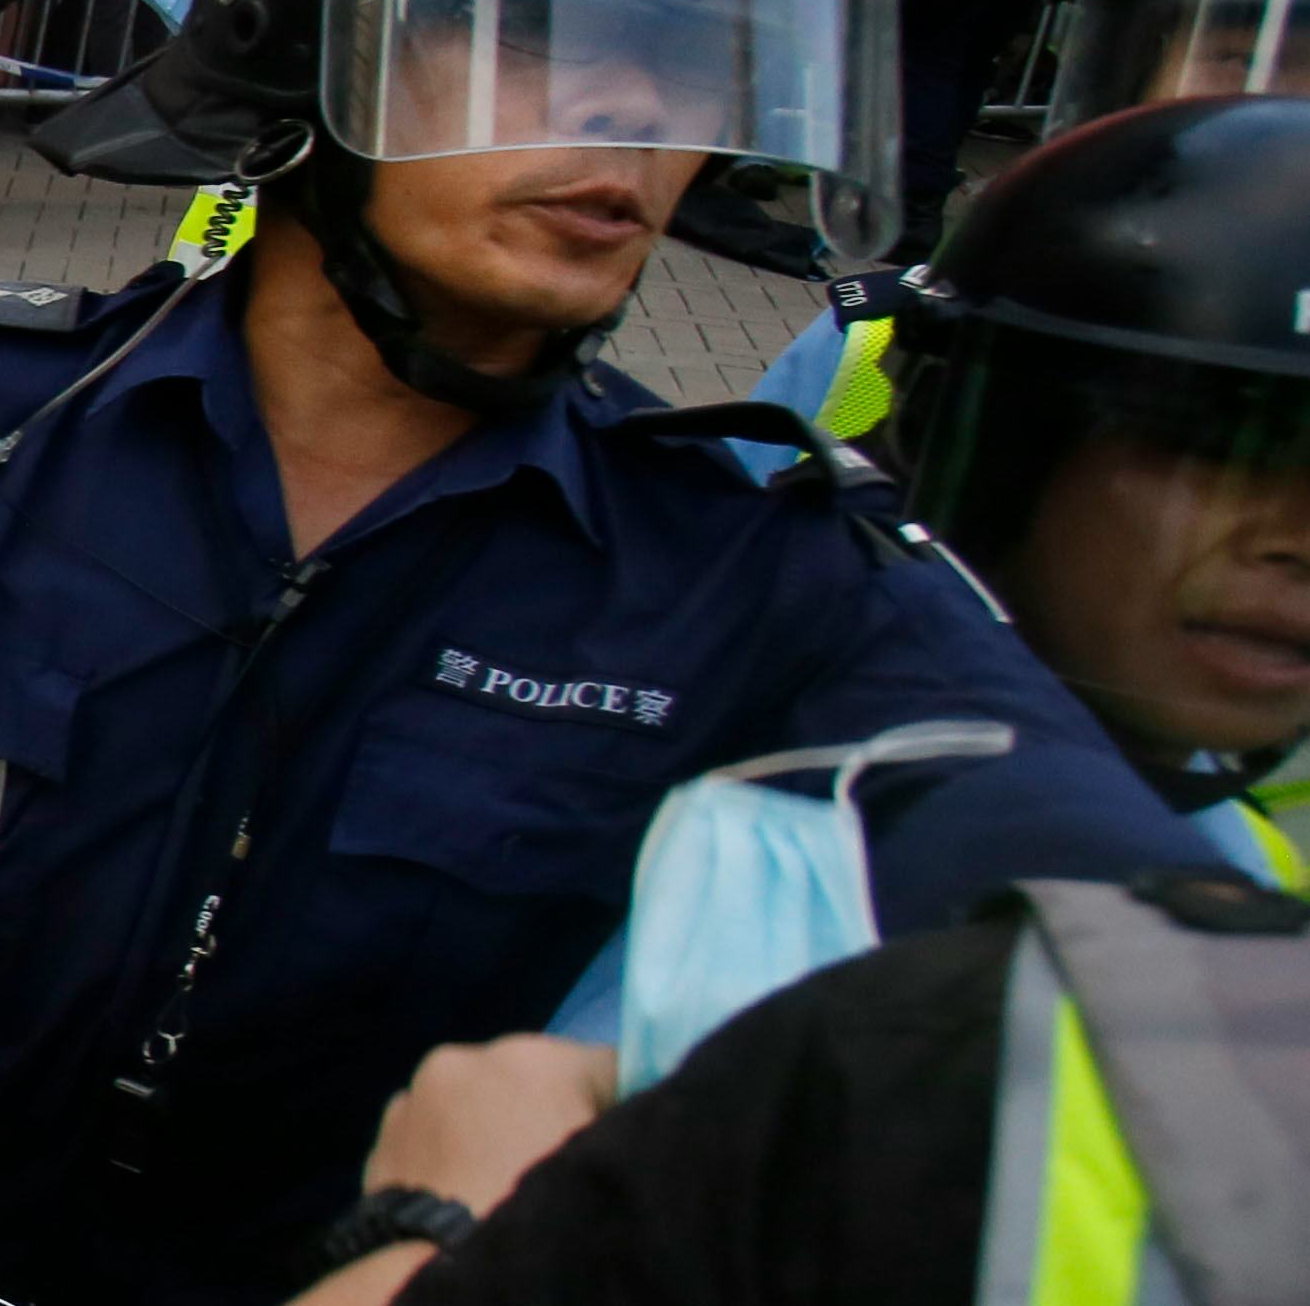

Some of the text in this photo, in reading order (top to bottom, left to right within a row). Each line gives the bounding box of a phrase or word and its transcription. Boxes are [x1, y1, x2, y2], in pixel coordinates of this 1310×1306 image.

[435, 648, 673, 727] 警 POLICE 察
